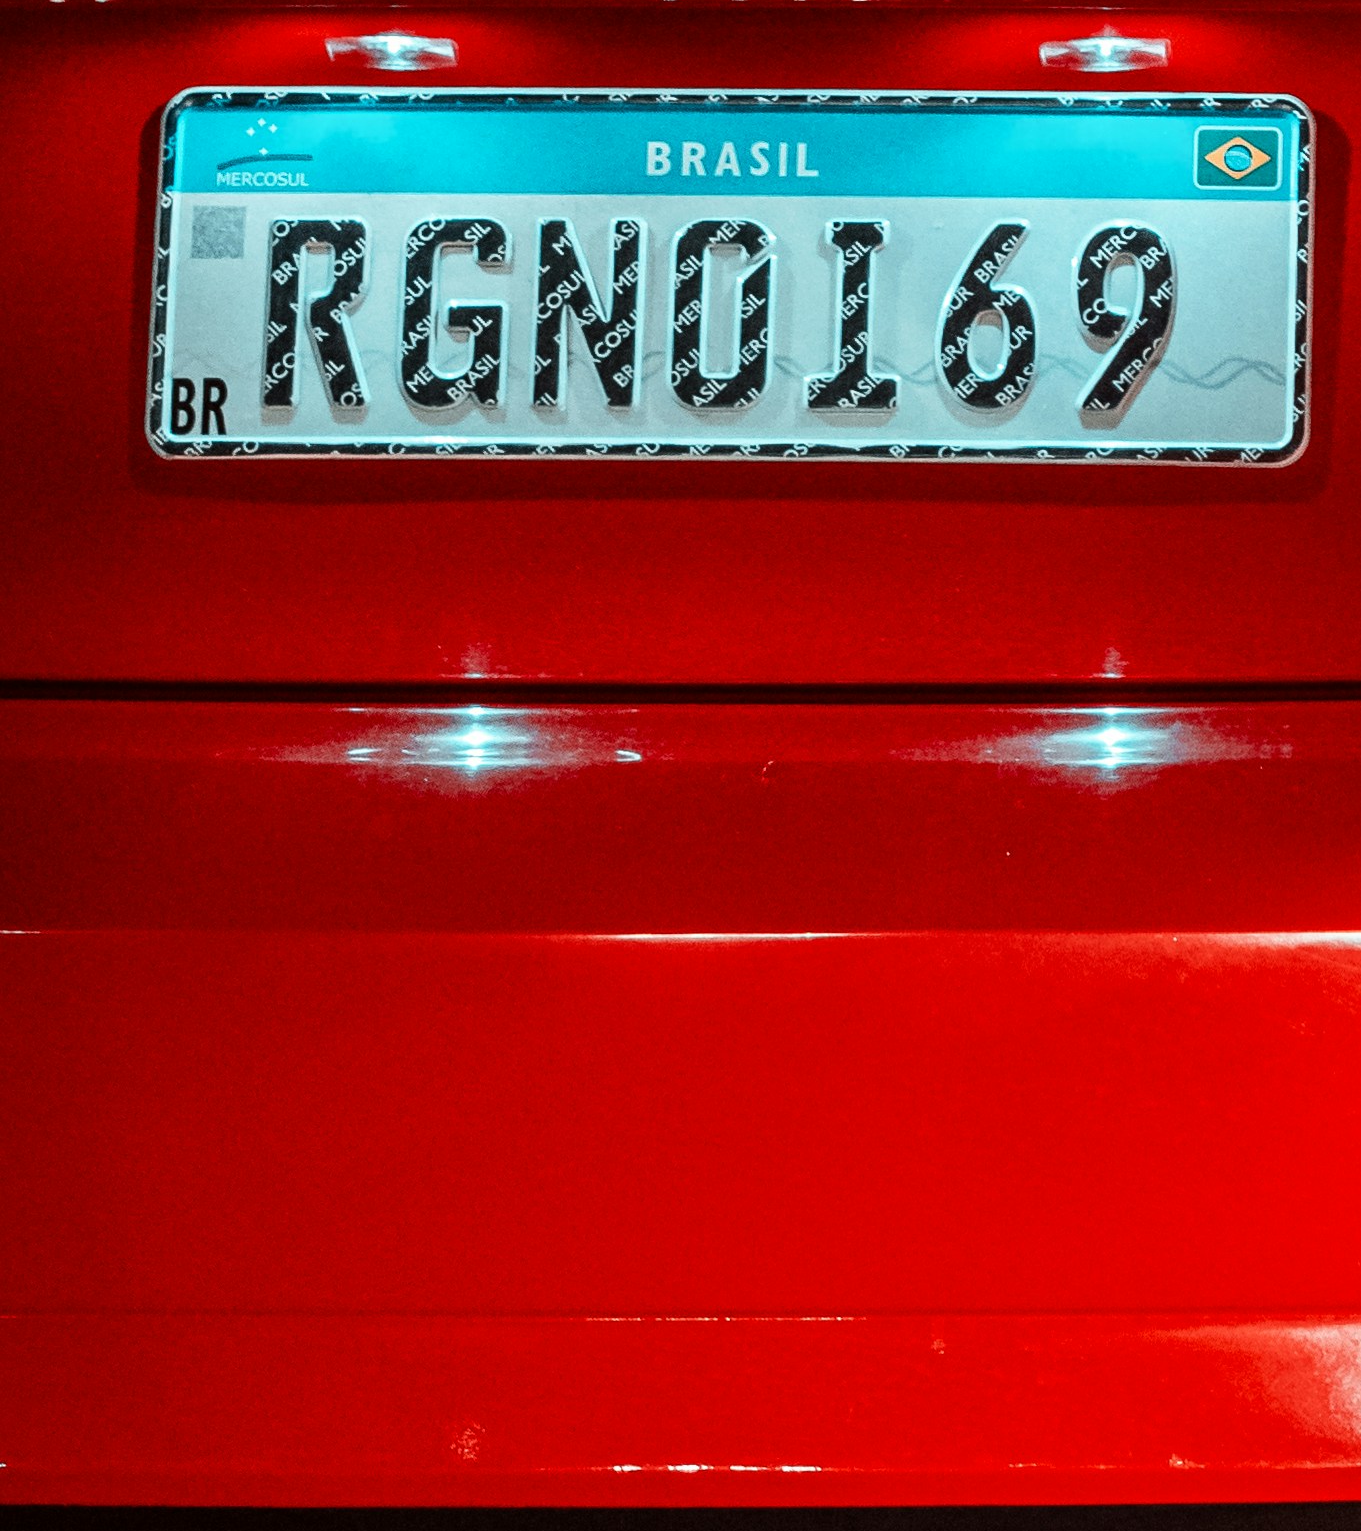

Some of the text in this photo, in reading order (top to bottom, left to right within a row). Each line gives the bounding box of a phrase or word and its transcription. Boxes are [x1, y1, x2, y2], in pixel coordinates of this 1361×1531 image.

[216, 172, 309, 187] MERCOSUL
[646, 141, 820, 177] BRASIL
[447, 354, 501, 402] BRASIL
[172, 378, 228, 435] BR
